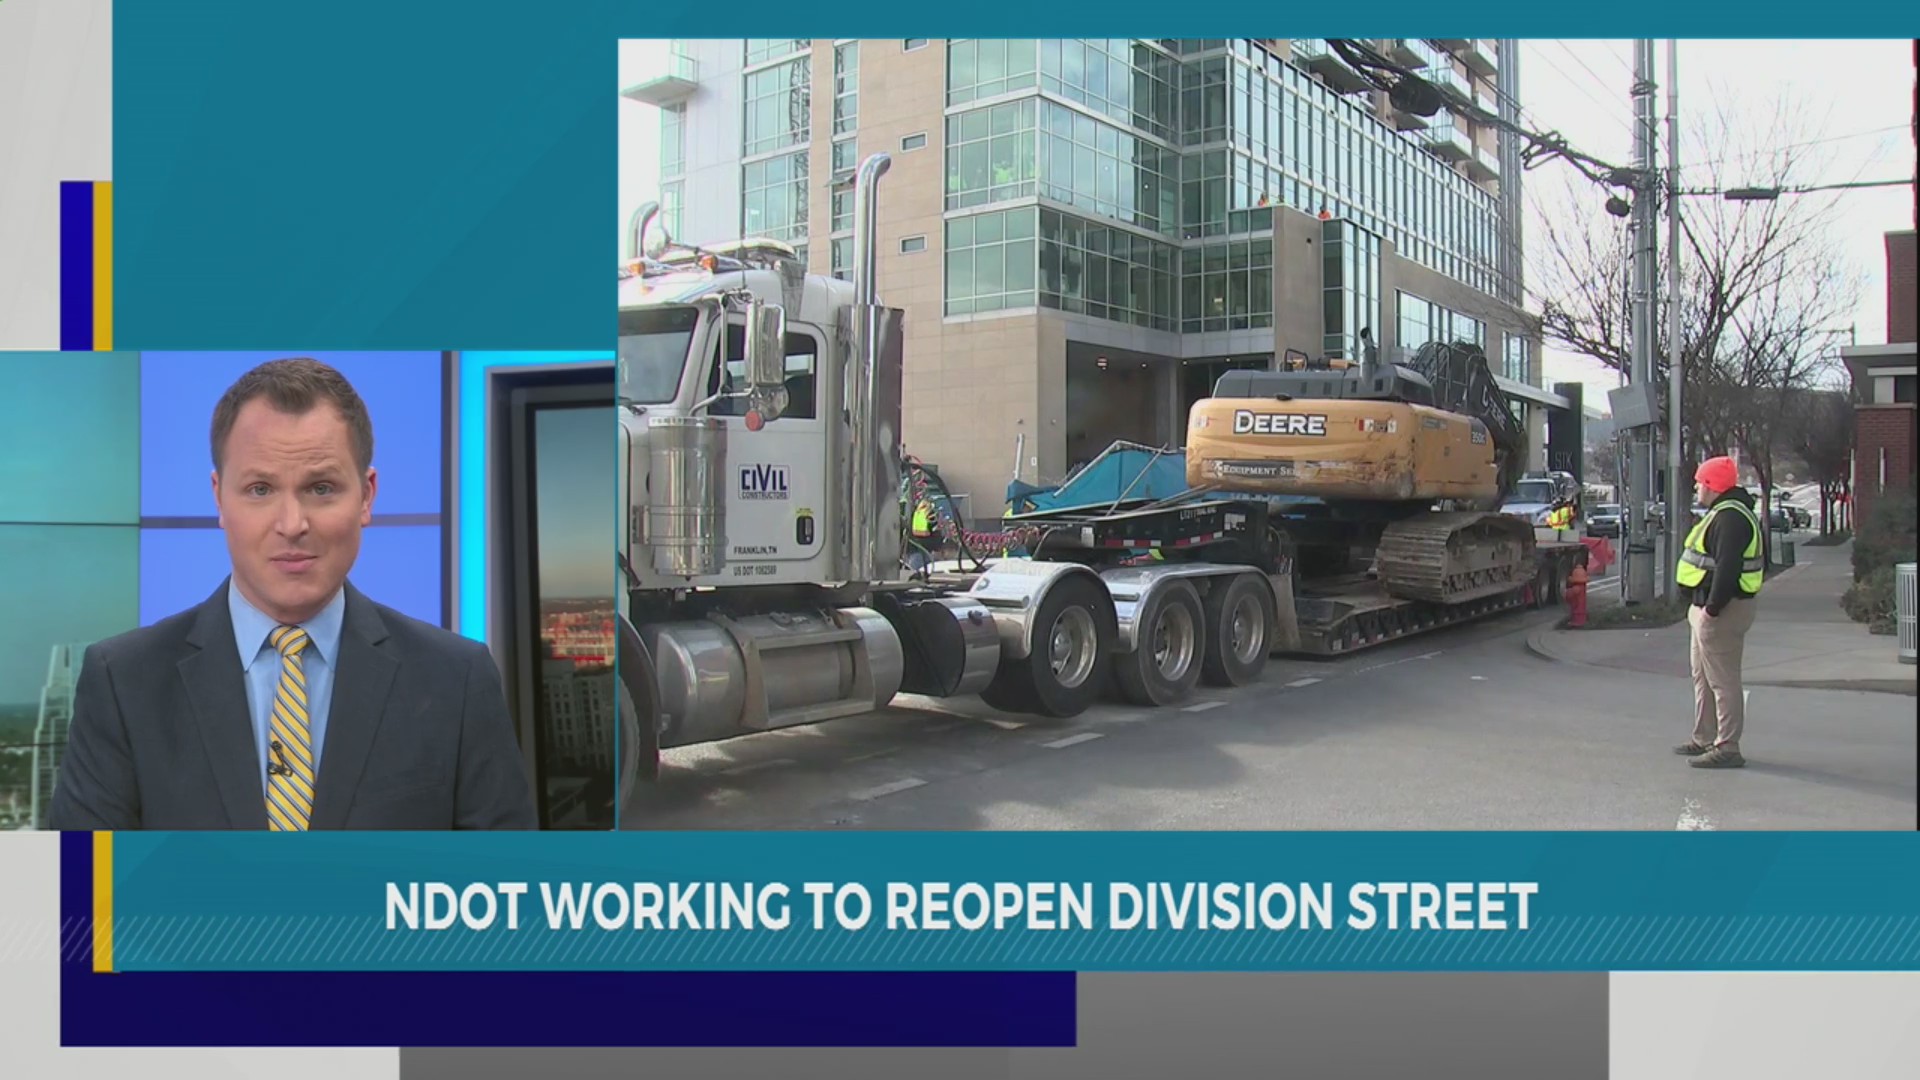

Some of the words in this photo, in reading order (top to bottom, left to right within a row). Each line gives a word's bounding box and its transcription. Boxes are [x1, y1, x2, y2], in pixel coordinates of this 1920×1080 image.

[1234, 409, 1327, 436] DEERE
[1223, 464, 1277, 476] EQUIPMENT
[741, 464, 787, 491] CIVIL
[742, 491, 787, 499] CONSTRUCTORS
[733, 566, 742, 576] US
[743, 565, 754, 576] DOT
